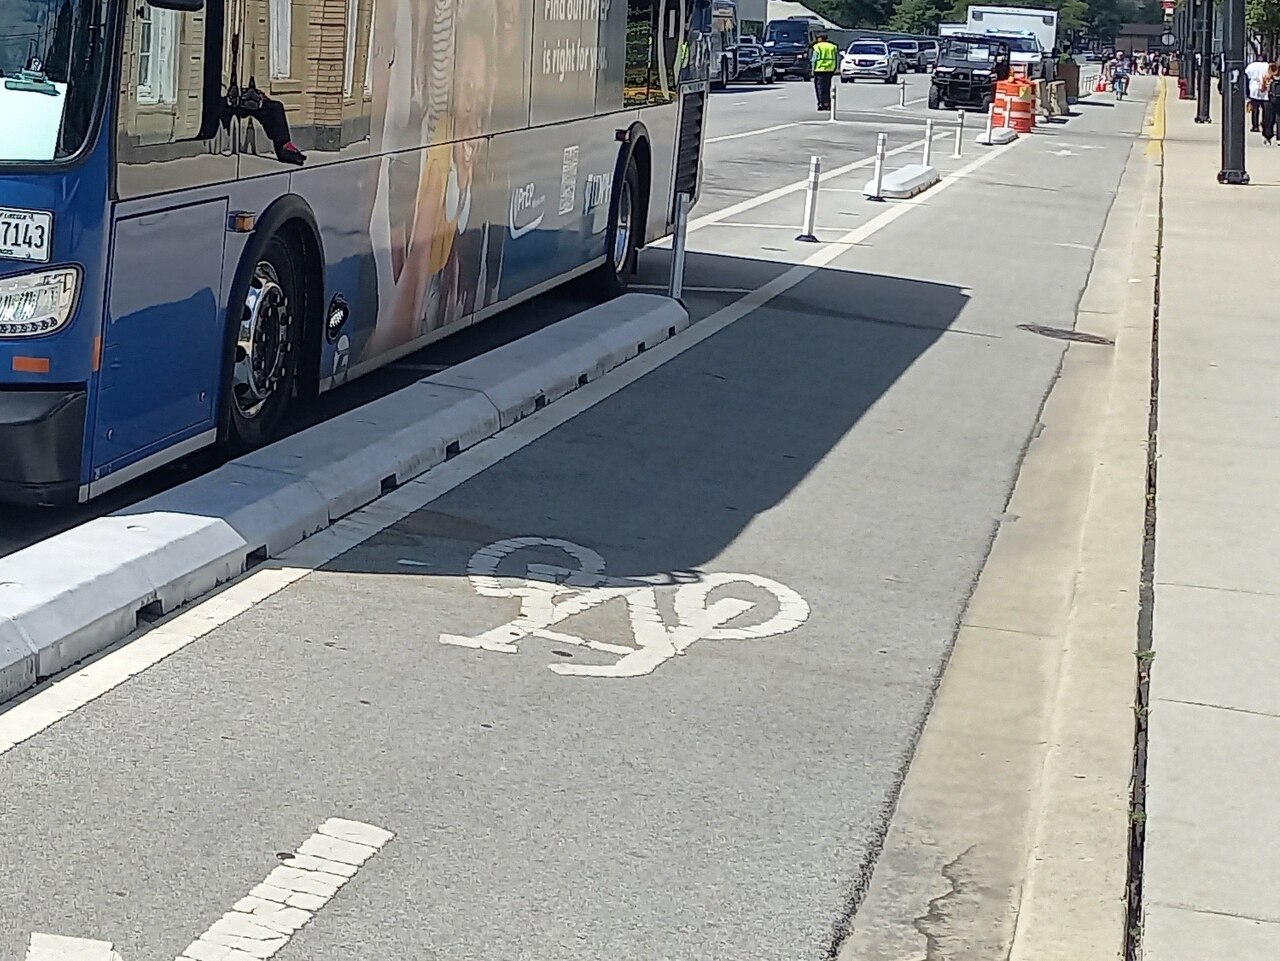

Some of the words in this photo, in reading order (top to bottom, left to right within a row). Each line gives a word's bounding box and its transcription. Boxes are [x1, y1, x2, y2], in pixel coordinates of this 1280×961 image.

[542, 40, 551, 75] is
[552, 38, 575, 82] right
[576, 37, 589, 72] for
